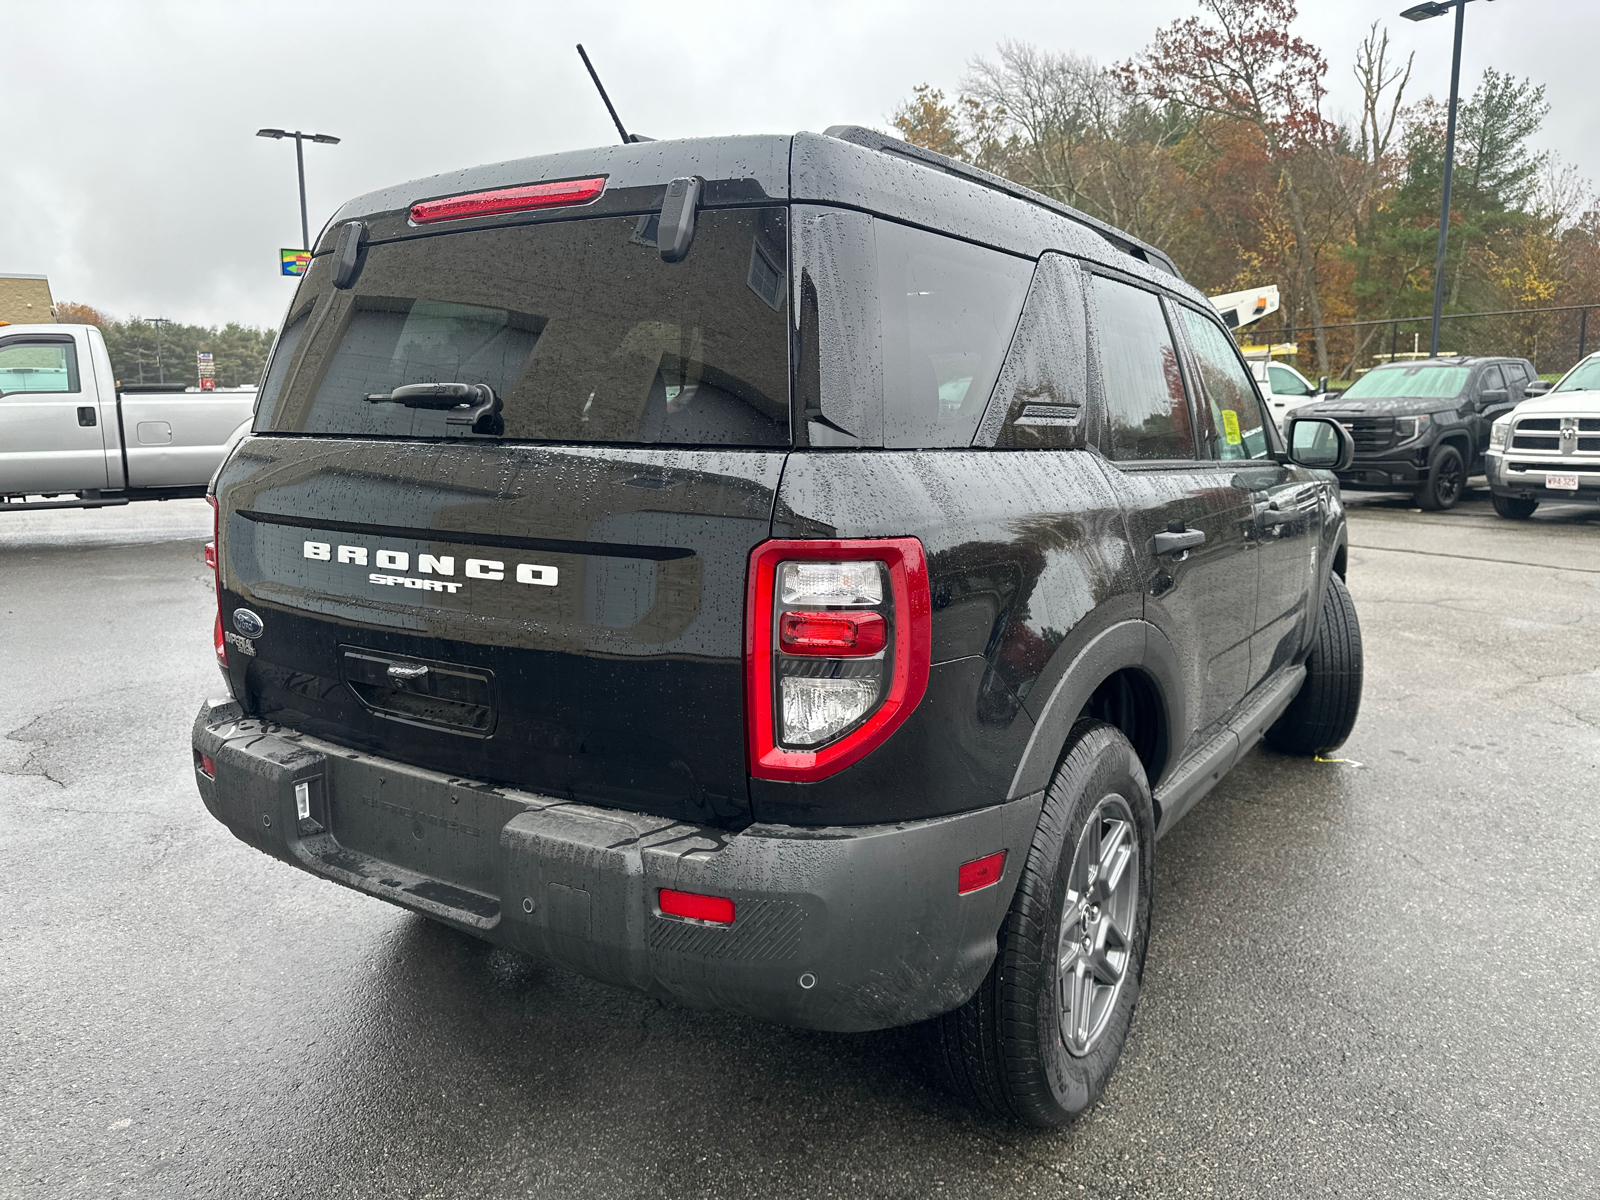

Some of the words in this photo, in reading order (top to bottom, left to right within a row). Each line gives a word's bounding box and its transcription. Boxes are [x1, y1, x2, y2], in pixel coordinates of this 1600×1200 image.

[303, 540, 559, 587] BRONCO
[369, 573, 463, 593] SPORT
[237, 613, 254, 631] Ford
[362, 795, 481, 837] BRONCO
